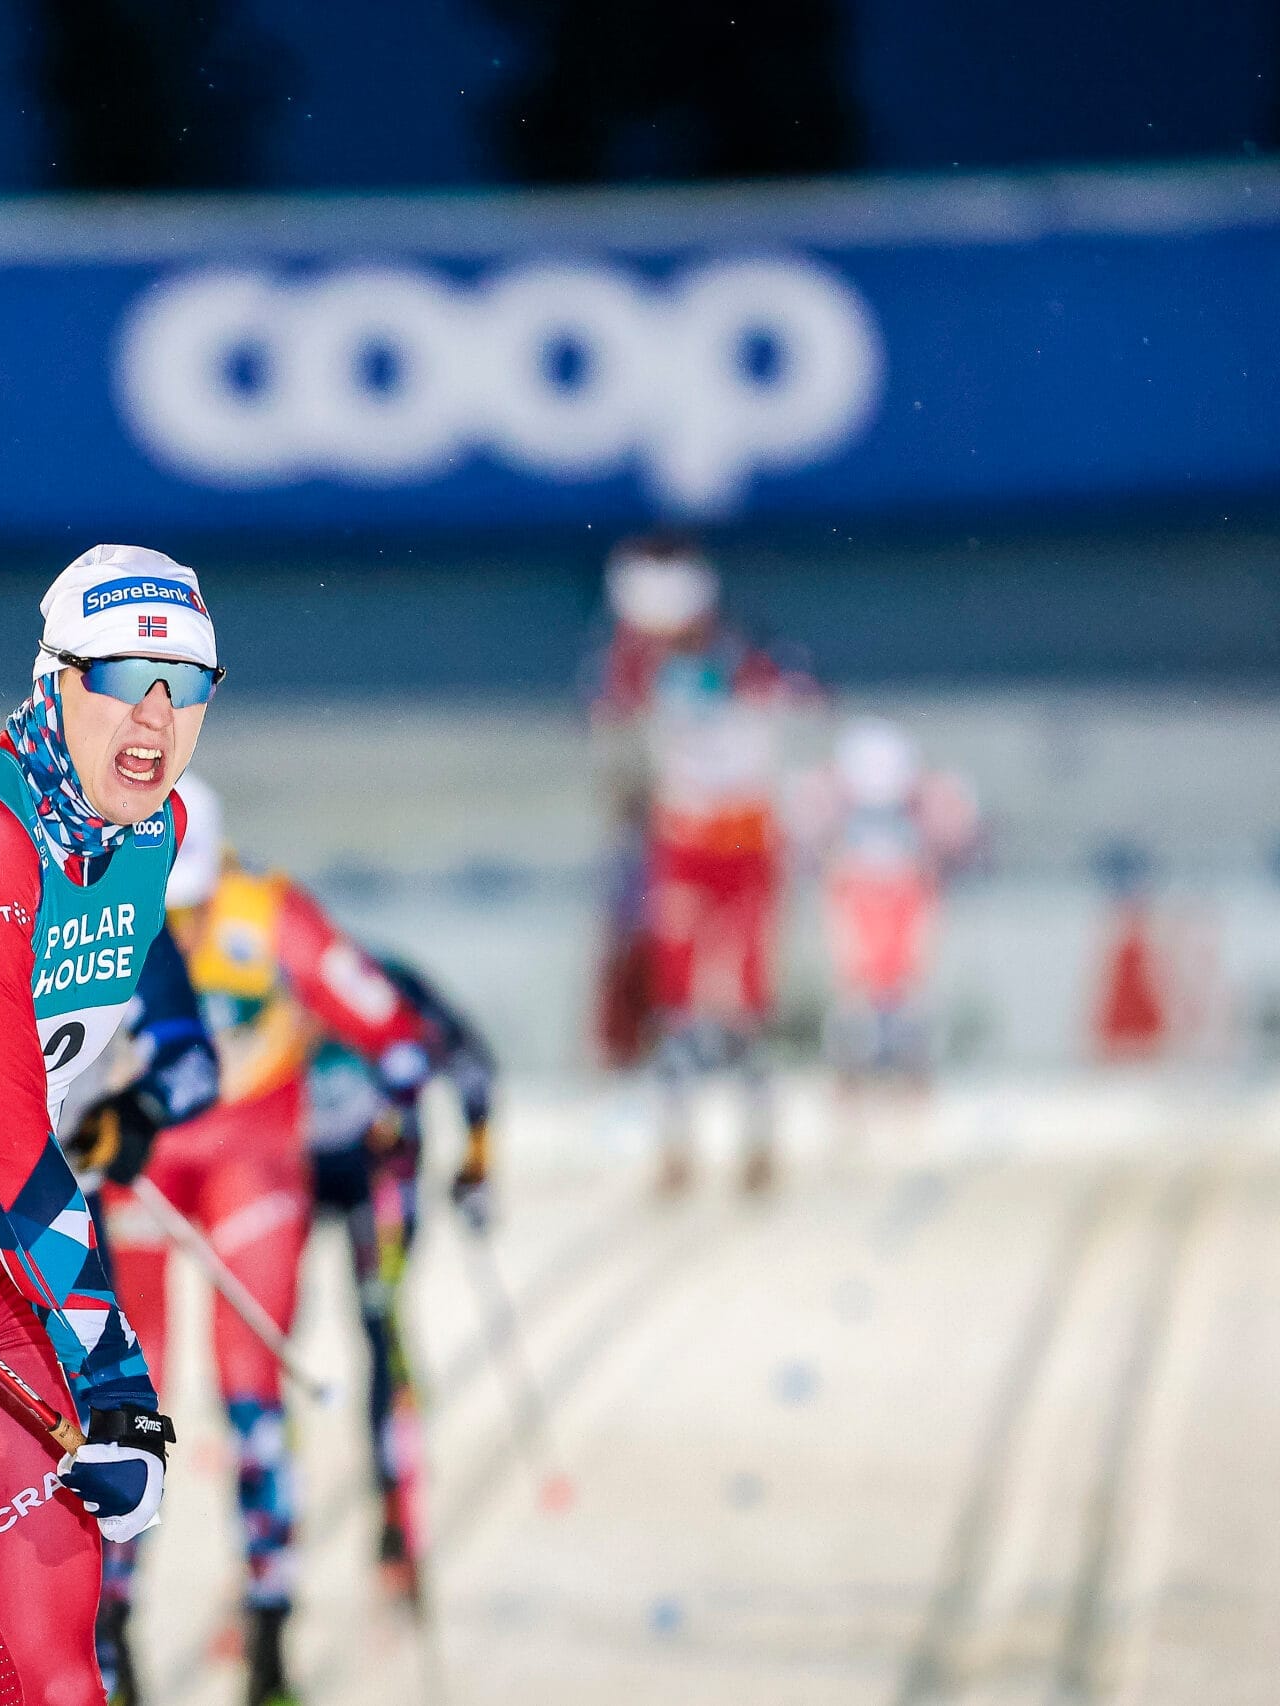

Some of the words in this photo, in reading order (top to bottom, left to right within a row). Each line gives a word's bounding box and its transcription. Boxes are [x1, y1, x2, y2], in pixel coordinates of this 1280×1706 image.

[118, 258, 884, 510] coop
[86, 582, 191, 610] SpareBank
[44, 903, 136, 959] POLAR
[33, 946, 134, 998] HOUSE
